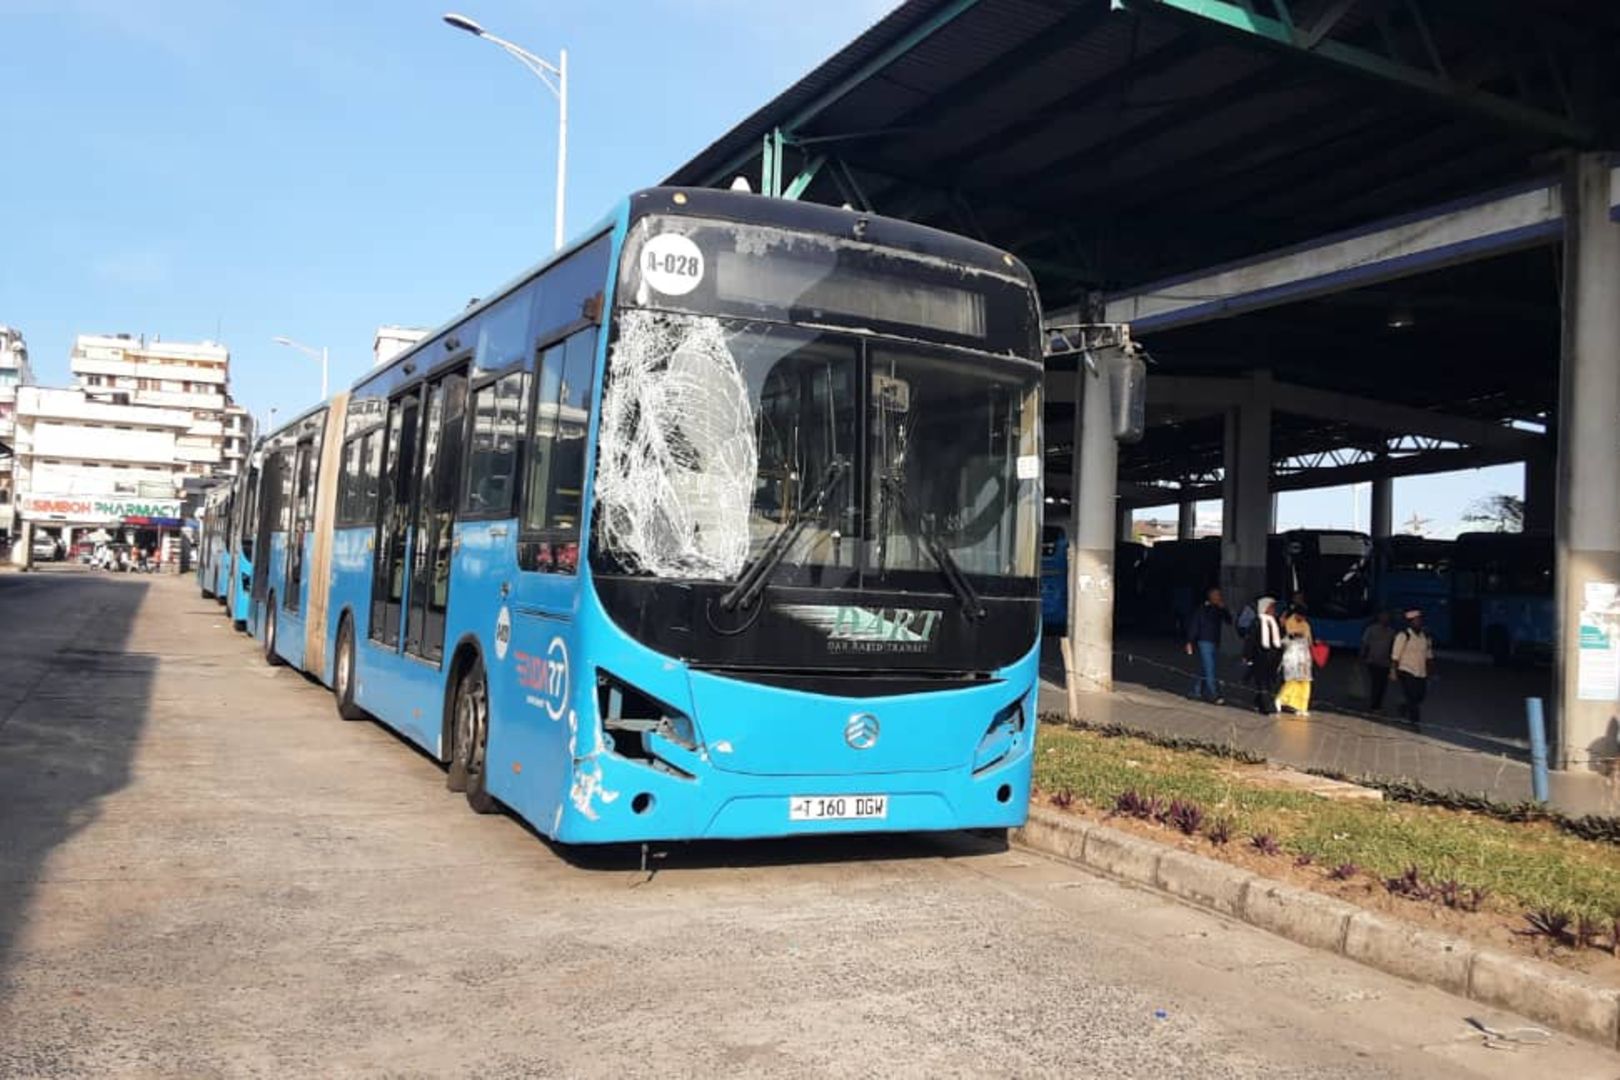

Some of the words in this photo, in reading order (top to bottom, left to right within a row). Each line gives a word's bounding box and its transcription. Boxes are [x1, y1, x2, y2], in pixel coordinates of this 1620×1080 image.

[647, 251, 699, 277] A-028
[94, 501, 180, 517] PHARMACY
[827, 605, 943, 642] DART
[803, 799, 812, 817] T
[816, 799, 846, 817] 160
[855, 798, 883, 815] DGW
